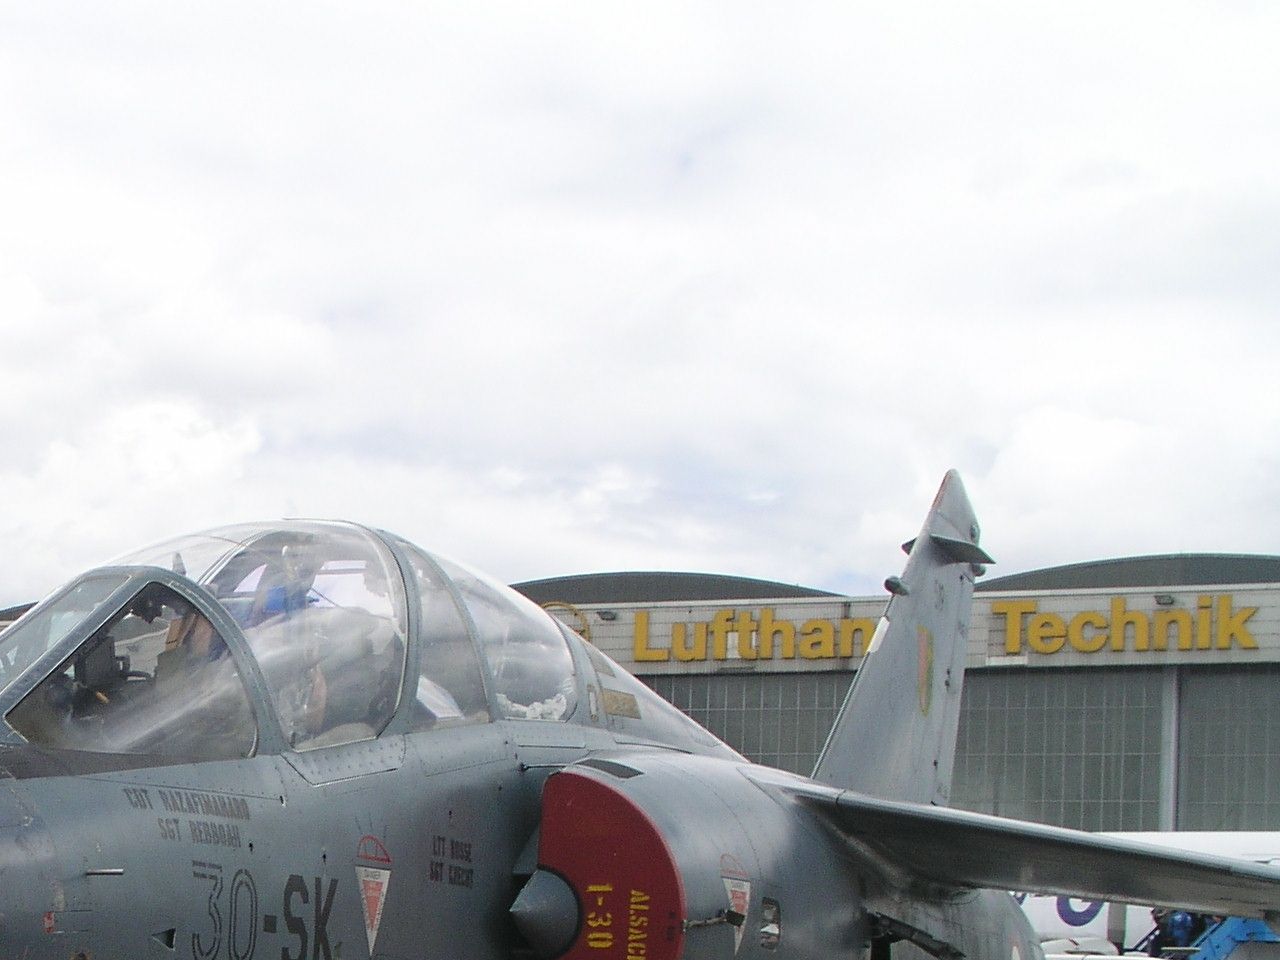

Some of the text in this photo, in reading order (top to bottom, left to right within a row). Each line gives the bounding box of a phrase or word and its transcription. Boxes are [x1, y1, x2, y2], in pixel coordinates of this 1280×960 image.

[633, 592, 1260, 663] Lufthan Technik
[586, 883, 614, 949] 1-30
